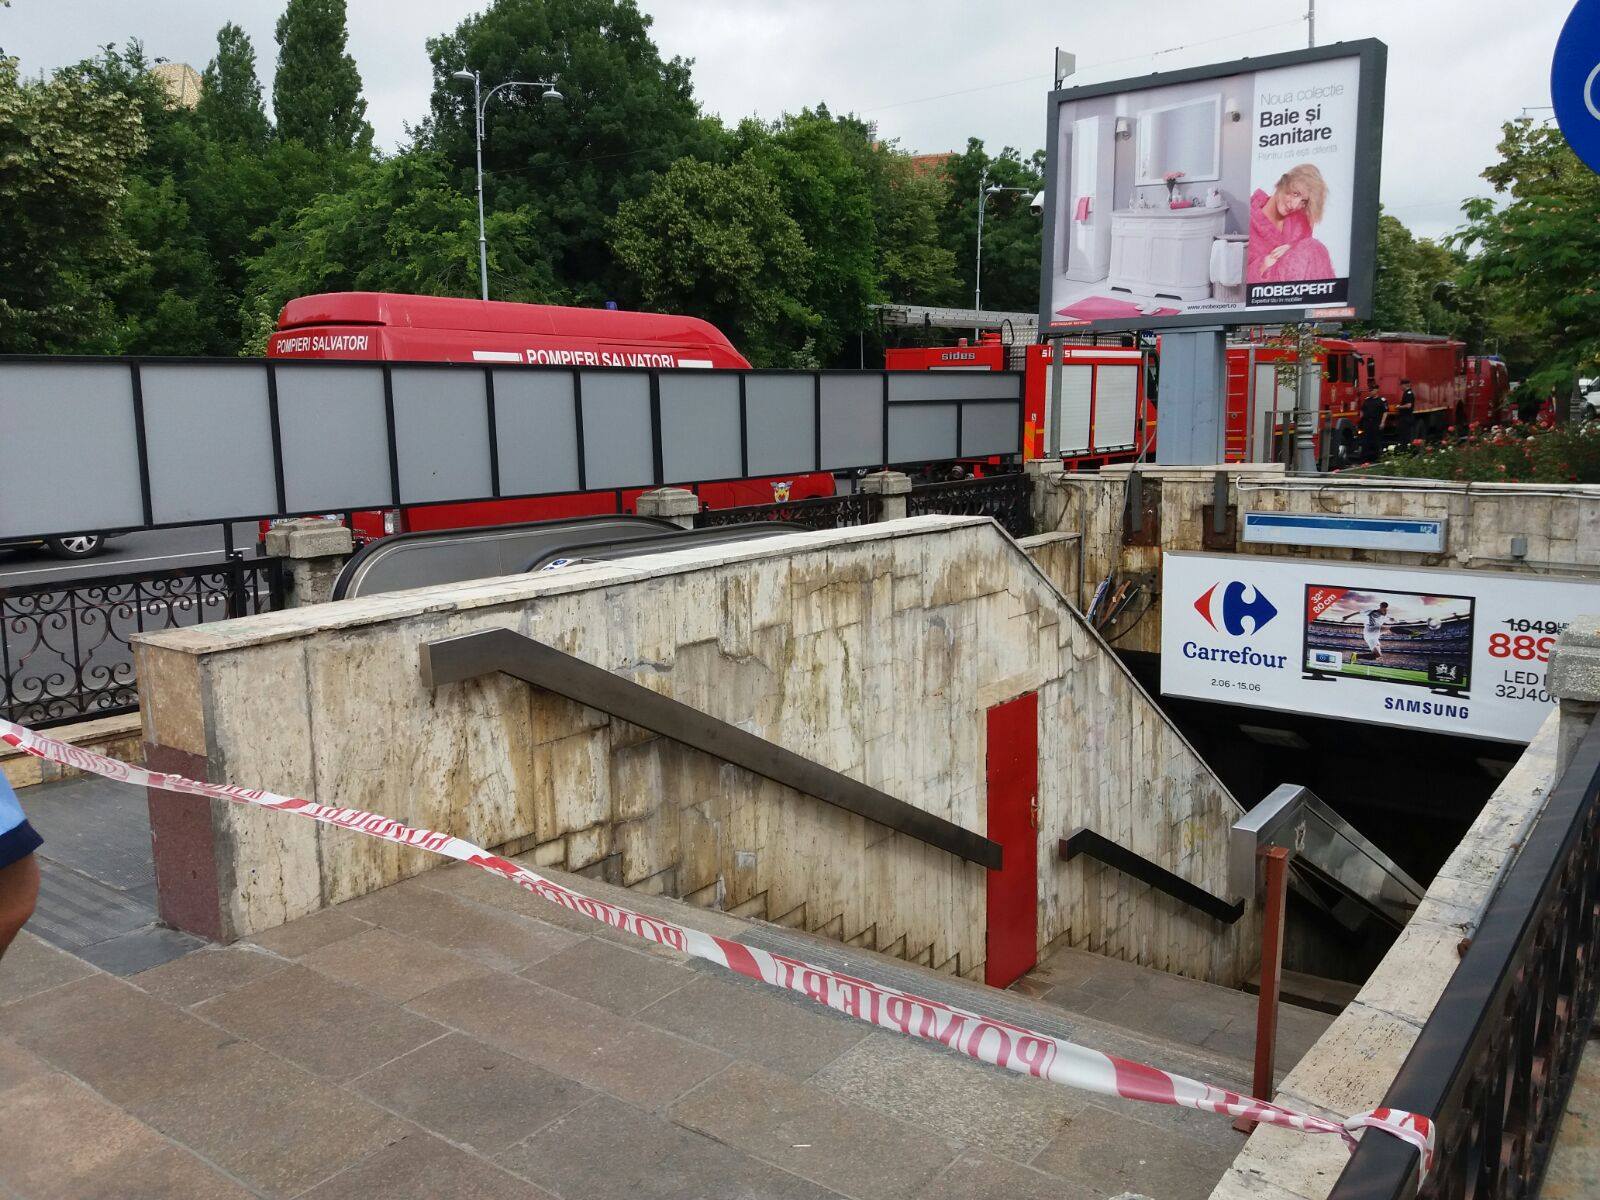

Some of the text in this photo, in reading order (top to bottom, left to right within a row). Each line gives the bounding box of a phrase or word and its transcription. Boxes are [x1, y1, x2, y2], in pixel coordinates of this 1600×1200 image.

[1259, 103, 1322, 128] Baie și
[1258, 126, 1332, 148] sanitare
[1251, 281, 1337, 298] MOBEXPERT
[276, 335, 369, 354] POMPIERI SALVATORI
[1041, 347, 1071, 358] sis
[941, 350, 976, 361] sides
[1312, 594, 1337, 614] 80 cm
[1182, 641, 1288, 669] Carrefour
[1211, 678, 1231, 689] 2.06
[1236, 681, 1261, 692] 15.06
[1504, 670, 1539, 686] LED
[1384, 696, 1470, 719] SAMSUNG
